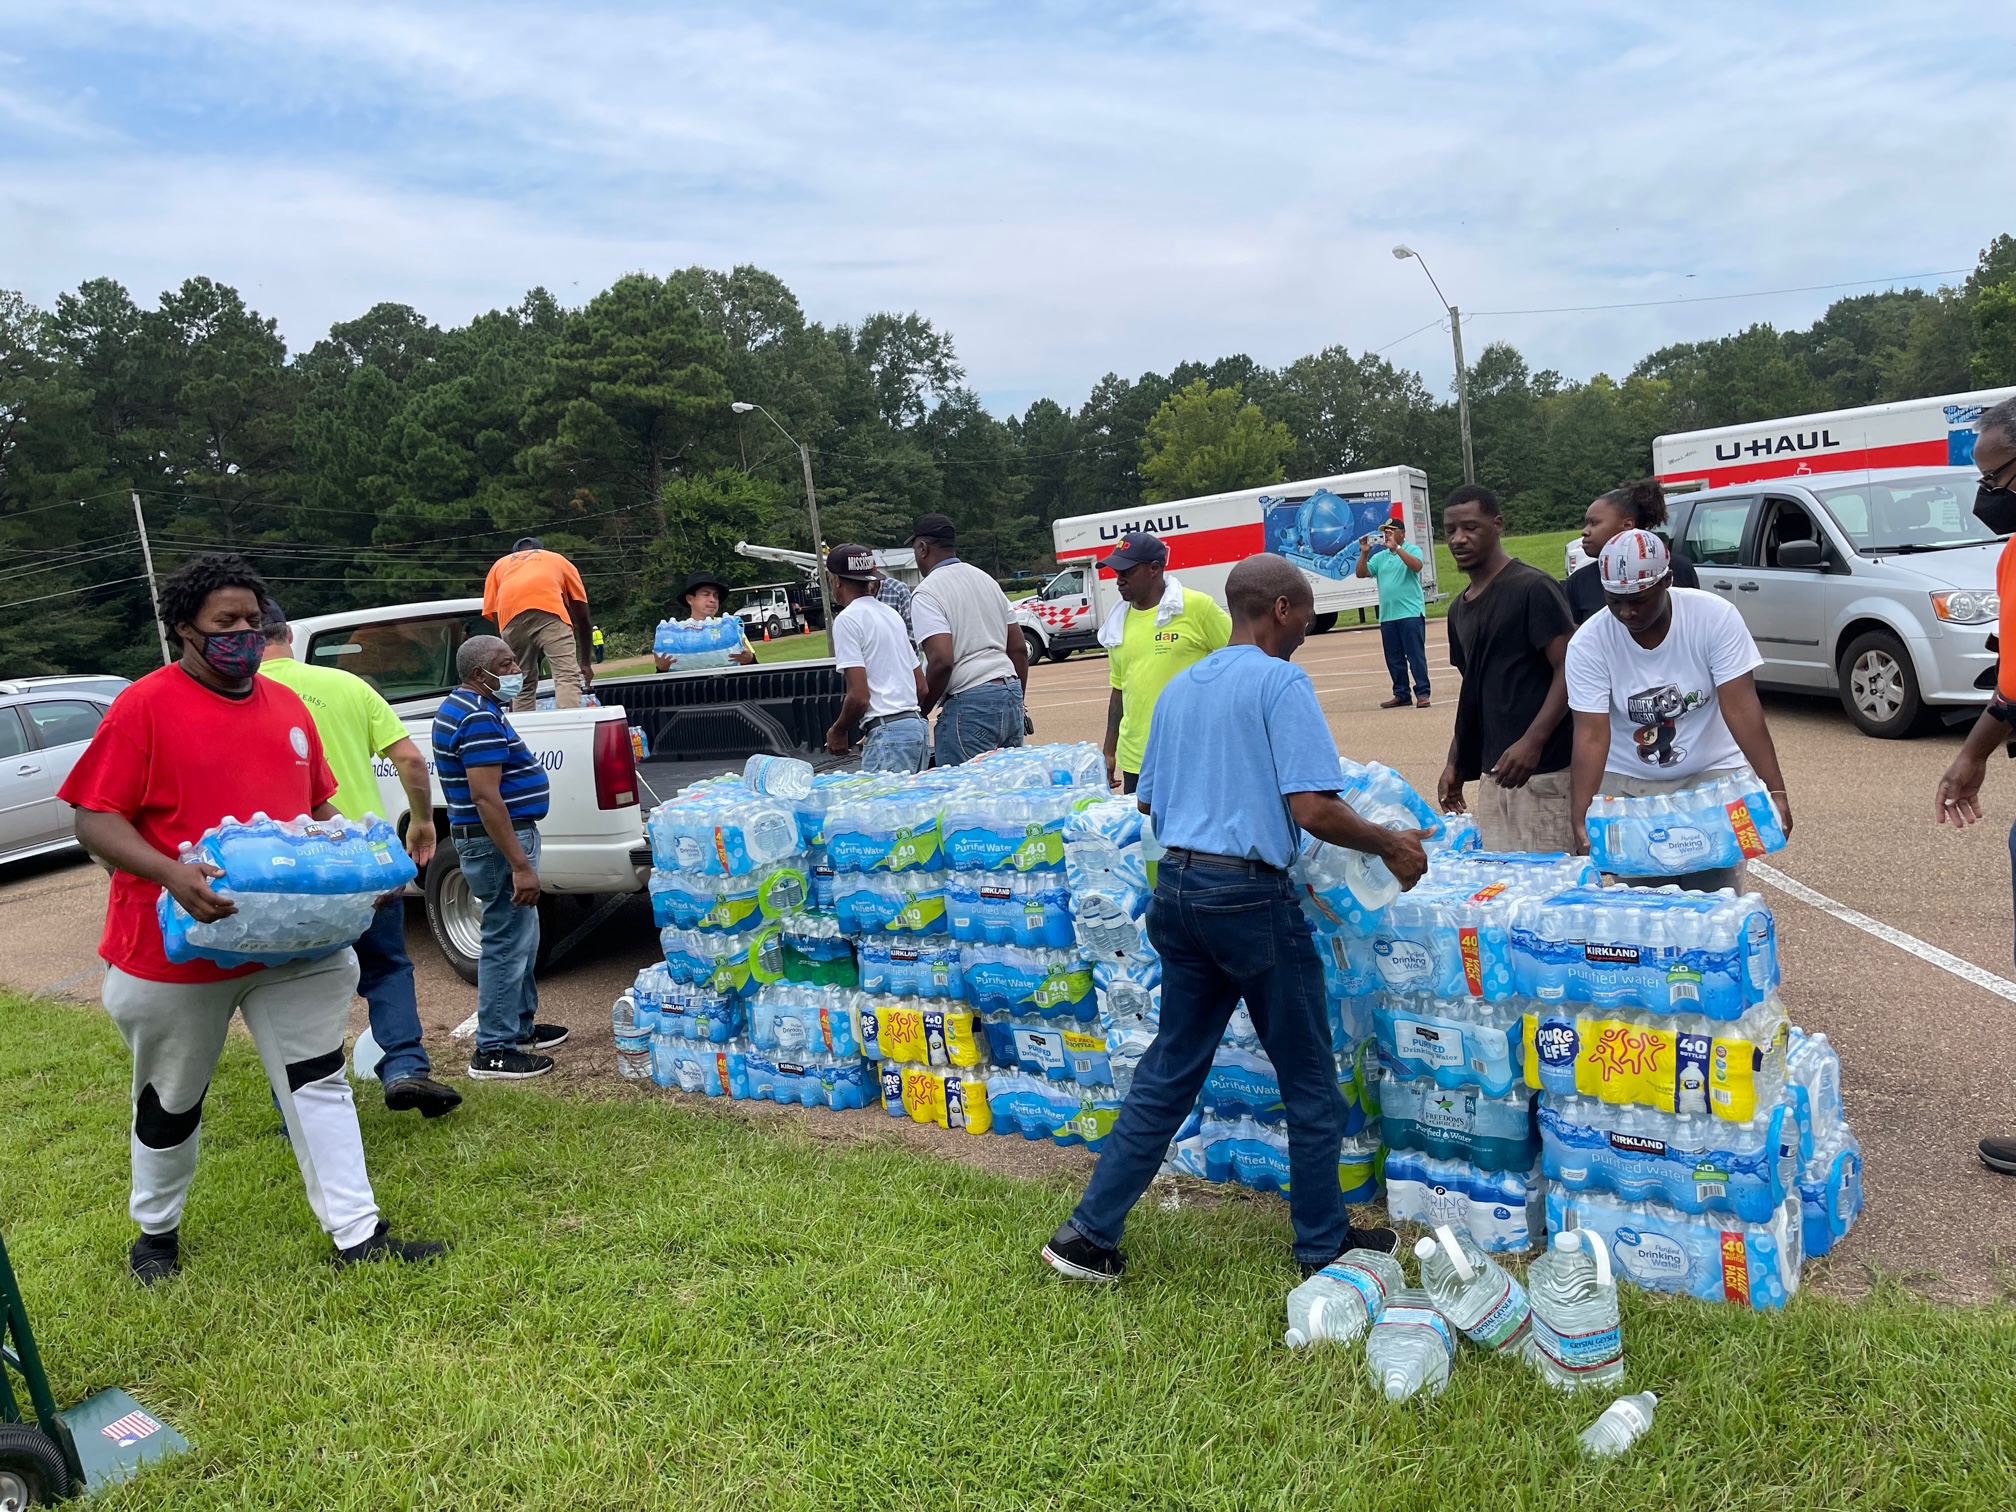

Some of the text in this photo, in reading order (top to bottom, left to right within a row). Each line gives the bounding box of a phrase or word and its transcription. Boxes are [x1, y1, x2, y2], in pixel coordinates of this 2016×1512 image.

[1715, 430, 1840, 461] U-HAUL
[1099, 515, 1189, 540] U-HAUL
[1155, 632, 1179, 642] dap
[298, 693, 326, 709] EMS?
[534, 750, 563, 771] 400
[1731, 806, 1747, 820] 40
[1668, 840, 1702, 850] Drinking
[1737, 830, 1752, 850] PACK
[899, 845, 915, 857] 40
[986, 844, 1012, 853] Water
[1025, 842, 1046, 855] 40
[981, 887, 1010, 895] KIRKLAND
[907, 908, 920, 920] 40
[1461, 935, 1477, 946] 40
[890, 949, 918, 957] KIRKLAND
[1587, 946, 1638, 958] KIRKLAND
[1392, 957, 1426, 965] Drinking
[1465, 957, 1476, 979] PACK
[718, 971, 731, 981] 40
[1568, 967, 1661, 989] purified water
[1008, 979, 1035, 988] Water
[1049, 981, 1068, 992] 40
[925, 1015, 942, 1025] 40
[1680, 1038, 1707, 1054] 40
[1680, 1051, 1707, 1059] BOTTLES
[947, 1080, 960, 1090] 40
[1211, 1079, 1280, 1095] Purified Wate
[1081, 1116, 1097, 1129] 40
[1426, 1112, 1464, 1125] FREEDOM'S
[1432, 1120, 1457, 1128] CHOICE
[1416, 1123, 1441, 1138] Purified
[1450, 1132, 1472, 1143] Water
[1612, 1134, 1664, 1150] KIRKLAND
[1269, 1158, 1290, 1172] Wate
[1592, 1153, 1686, 1184] purified water
[1696, 1164, 1714, 1172] 40
[1419, 1187, 1468, 1208] SPRING
[1723, 1240, 1744, 1255] 40
[1638, 1250, 1681, 1263] Drinking
[1651, 1259, 1681, 1269] Water
[1725, 1264, 1737, 1289] PACK
[1473, 1317, 1495, 1335] CRYSTAL
[1494, 1298, 1513, 1318] GEYSER
[1570, 1340, 1594, 1349] CRYSTAL
[1595, 1334, 1618, 1344] GEYSER
